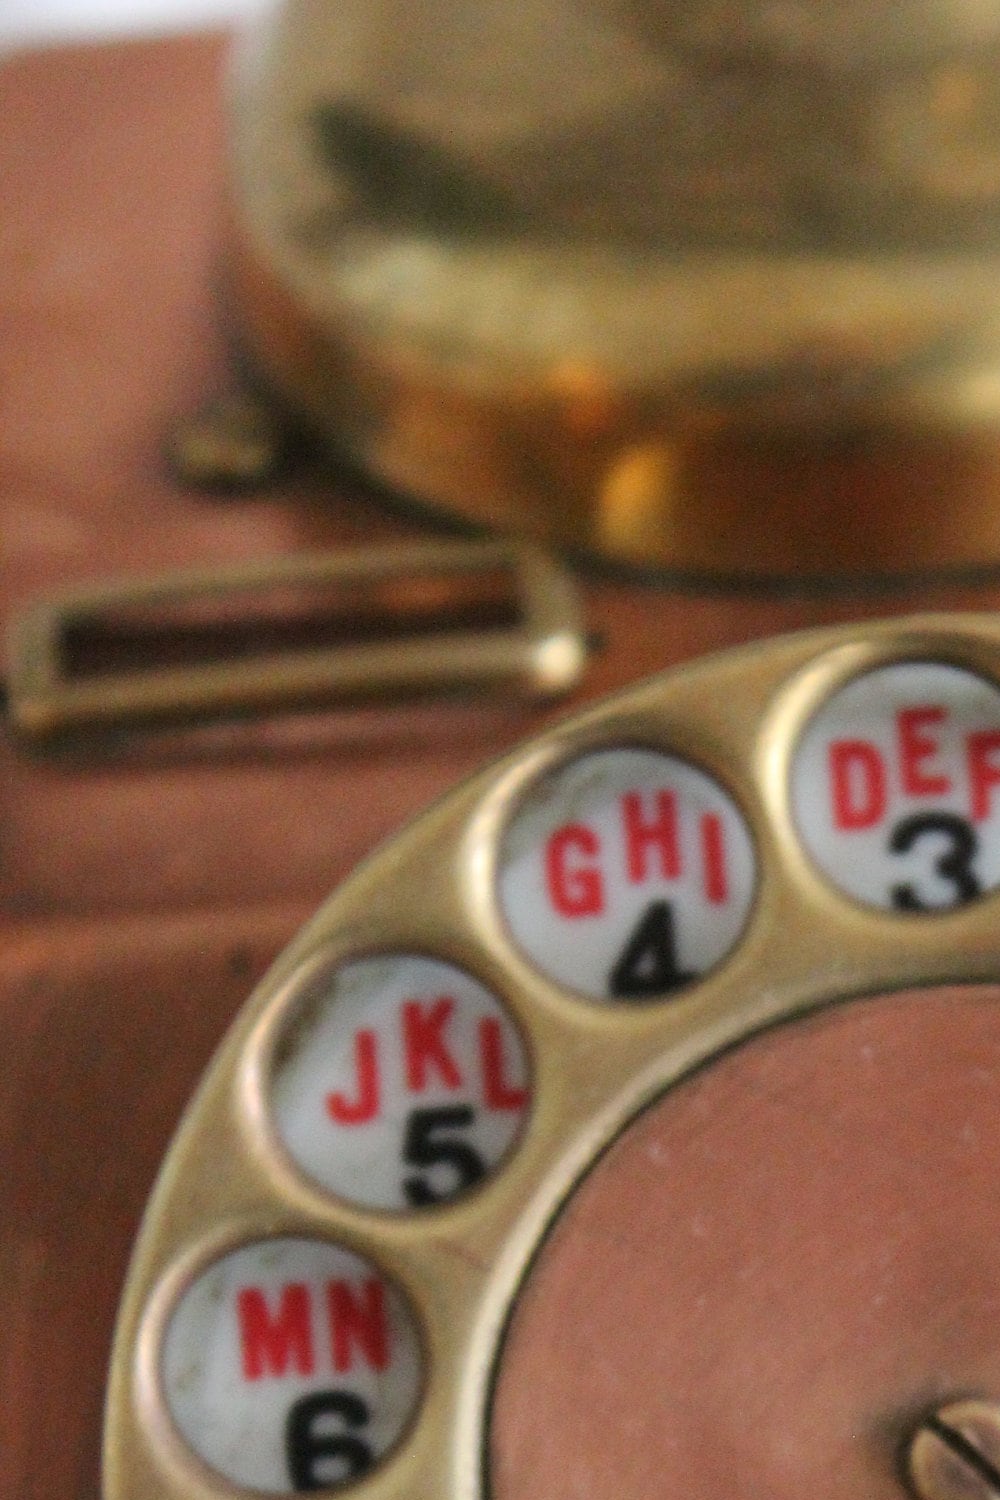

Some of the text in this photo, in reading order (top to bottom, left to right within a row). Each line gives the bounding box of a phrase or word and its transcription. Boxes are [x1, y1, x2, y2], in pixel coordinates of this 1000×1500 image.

[543, 788, 730, 921] GHI
[888, 812, 982, 914] 3
[607, 900, 701, 1001] 4
[325, 996, 531, 1127] JKL
[402, 1103, 492, 1210] 5
[236, 1278, 395, 1383] MN
[284, 1390, 380, 1496] 6
